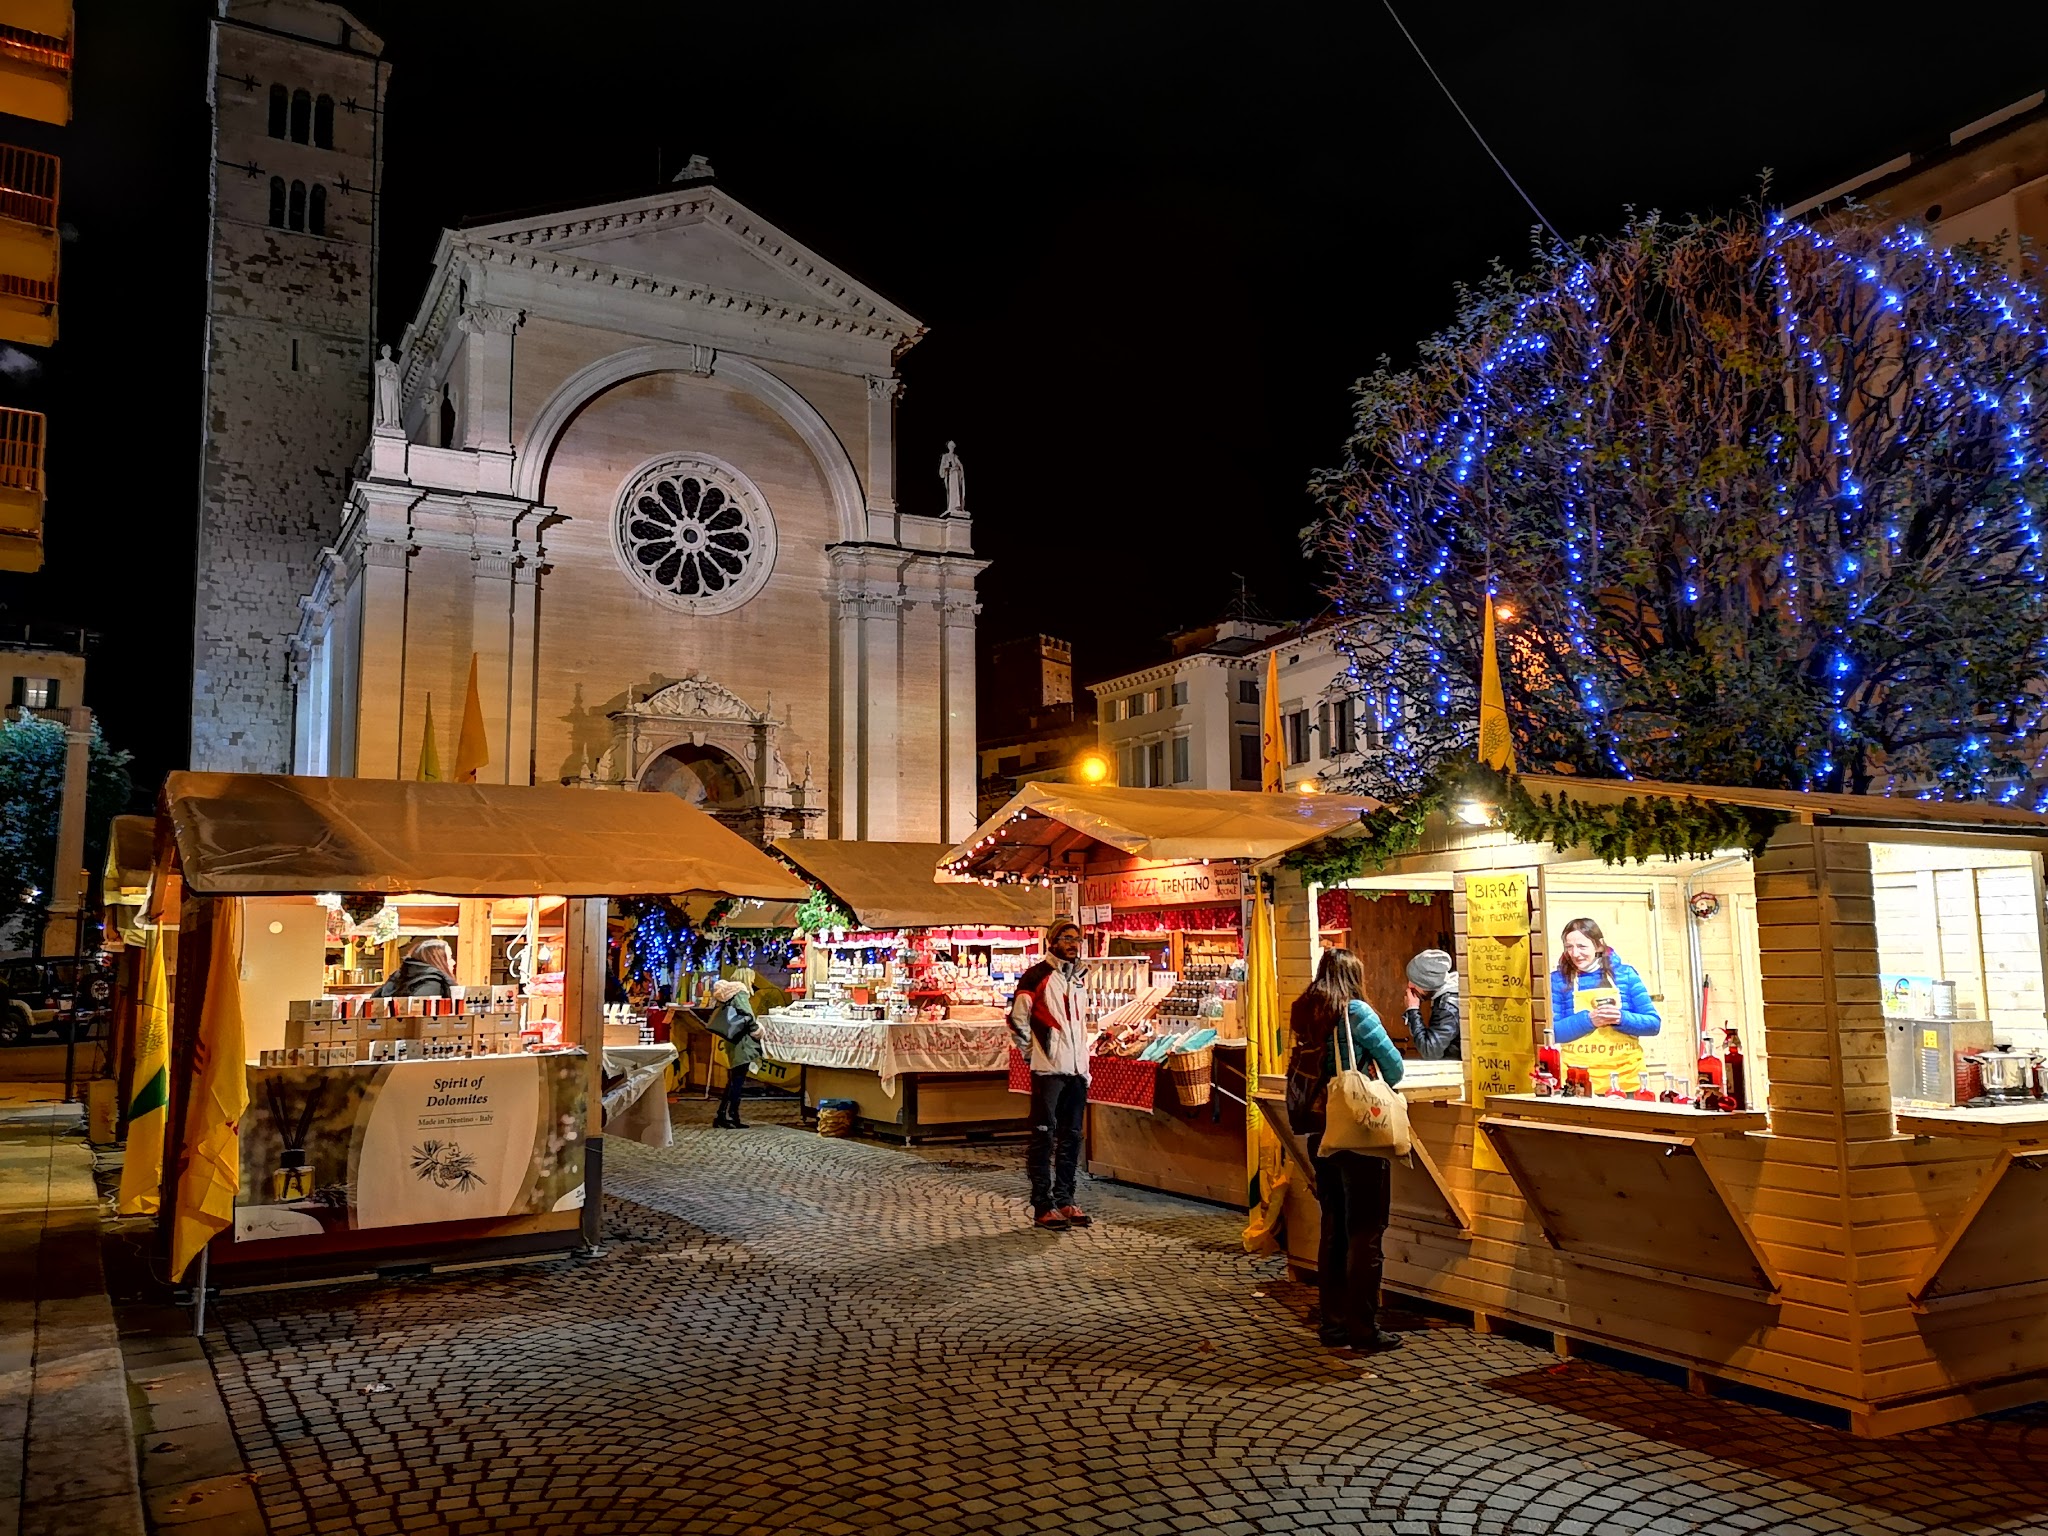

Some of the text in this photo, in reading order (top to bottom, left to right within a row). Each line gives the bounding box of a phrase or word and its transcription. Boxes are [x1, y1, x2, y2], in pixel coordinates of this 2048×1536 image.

[1085, 880, 1118, 902] VILLA
[1120, 878, 1159, 898] RIZZI
[1160, 876, 1210, 893] TRENTINO
[1474, 881, 1519, 899] BIRRA
[1489, 911, 1524, 922] FILTRATA
[1474, 1002, 1500, 1012] INFUSO
[1503, 1013, 1526, 1024] BOSCO
[1480, 1023, 1510, 1034] CALDO
[1577, 1044, 1607, 1054] CIBO
[1477, 1055, 1511, 1072] PUNCH
[1490, 1071, 1501, 1081] di
[433, 1075, 486, 1093] Spirit of
[1478, 1081, 1516, 1095] NATALE
[426, 1094, 489, 1108] Dolomites
[417, 1118, 437, 1127] Made
[437, 1117, 445, 1125] in
[446, 1116, 474, 1125] Trentino
[479, 1114, 494, 1123] Italy
